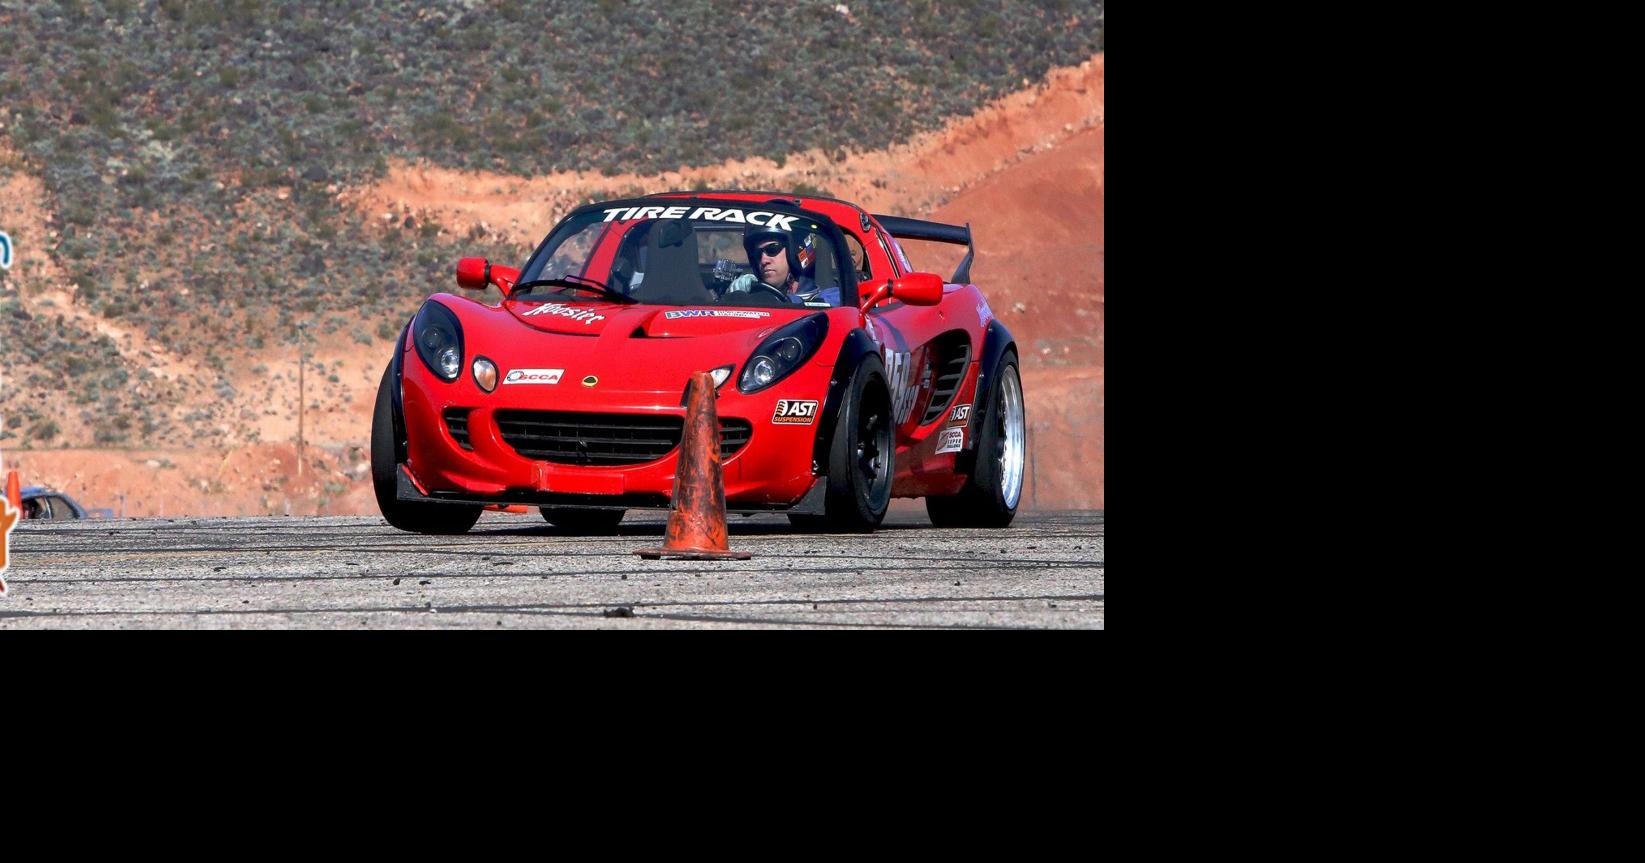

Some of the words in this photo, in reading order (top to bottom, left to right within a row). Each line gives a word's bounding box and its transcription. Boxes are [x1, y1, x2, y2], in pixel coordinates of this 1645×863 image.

[603, 206, 690, 222] TIRE
[688, 207, 799, 231] RACK
[666, 310, 716, 319] BWR
[787, 402, 816, 416] AST
[954, 406, 970, 420] AST
